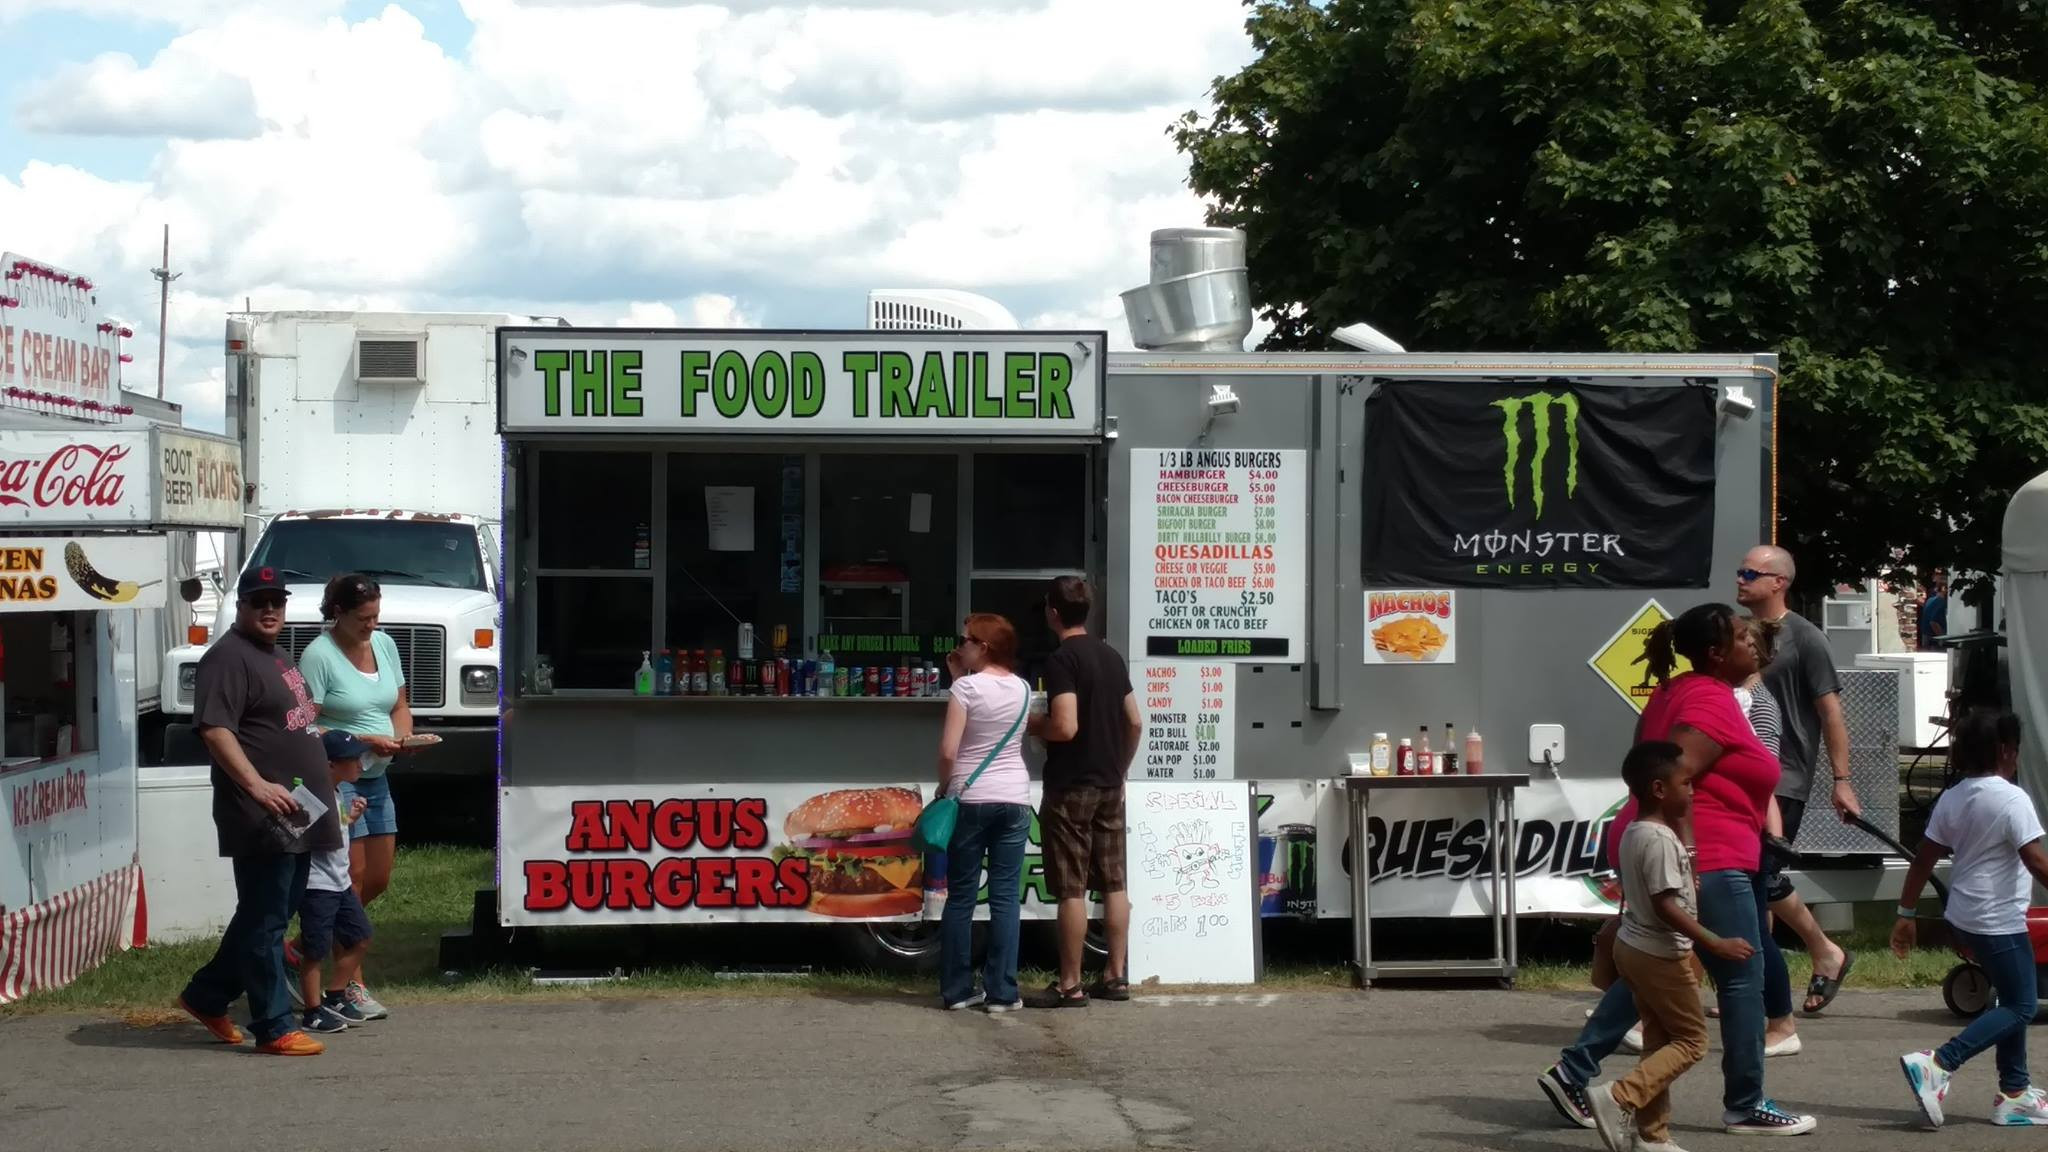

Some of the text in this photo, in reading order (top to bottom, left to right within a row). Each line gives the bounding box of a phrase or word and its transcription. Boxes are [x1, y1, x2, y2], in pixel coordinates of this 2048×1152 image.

[22, 329, 76, 383] CREAM
[80, 342, 110, 389] BAR
[535, 349, 1075, 419] THE FOOD TRAILER
[164, 448, 192, 475] ROOT
[1160, 451, 1281, 468] 1/3 LB ANGUS BURGERS
[197, 457, 240, 502] FLOATS
[1160, 469, 1278, 480] HAMBURGER $4.00
[165, 479, 193, 505] BEER
[1157, 482, 1275, 493] CHEESEBURGER $5.00
[1156, 494, 1275, 504] BACON CHEESEBURGER $6.00
[1157, 506, 1275, 518] SRIRACHA BURGER $7.00
[1157, 518, 1186, 530] BIGFOOT
[1188, 518, 1216, 530] BURGER
[1225, 532, 1251, 543] BURGER
[1453, 529, 1625, 558] MONSTER
[1155, 545, 1273, 561] QUESADILLAS
[1155, 562, 1275, 574] CHEESE OR VEGGIE $5.00
[1476, 563, 1600, 574] ENERGY
[1155, 577, 1274, 588] CHICKEN OR TACO BEEF $6.00
[1156, 590, 1274, 606] TACO'S $2.50
[1164, 606, 1258, 617] SOFT OR CRUNCHY
[1368, 591, 1451, 622] NACHOS
[1149, 618, 1268, 630] CHICKEN OR TACO BEEF
[1178, 640, 1251, 654] LOADED FRIES
[1146, 667, 1222, 678] NACHOS $3.00
[1147, 682, 1223, 693] CHIPS $1.00
[1147, 697, 1223, 709] CANDY $1.00
[1150, 713, 1220, 724] MONSTER $3.00
[1149, 727, 1164, 738] RED
[1167, 727, 1187, 738] BULL
[1149, 741, 1220, 752] GATORADE $2.00
[1147, 754, 1216, 765] CAN POP $1.00
[1147, 768, 1216, 779] WATER $1.00
[13, 767, 88, 827] ICE CREAM BAR
[566, 798, 767, 852] ANGUS
[1341, 815, 1620, 885] QUESADILL
[524, 857, 812, 911] BURGERS
